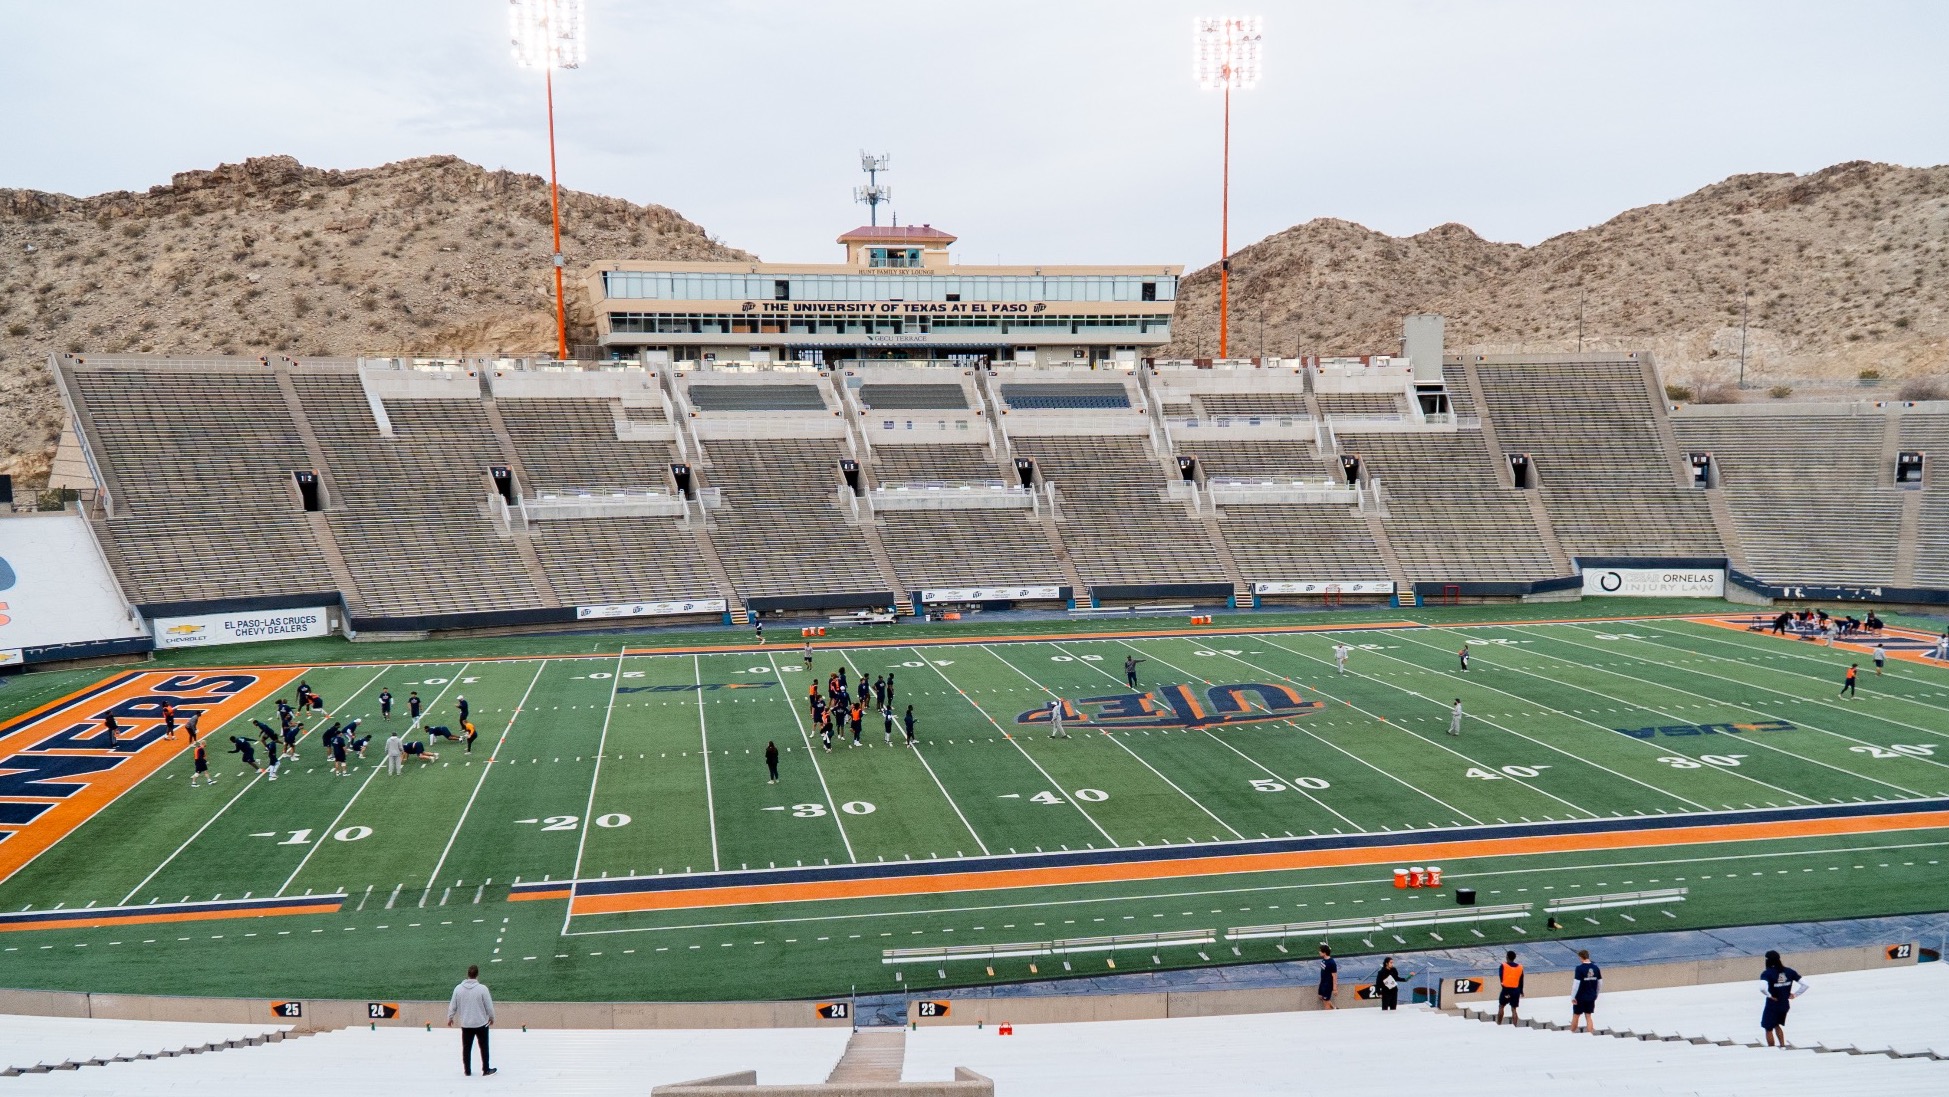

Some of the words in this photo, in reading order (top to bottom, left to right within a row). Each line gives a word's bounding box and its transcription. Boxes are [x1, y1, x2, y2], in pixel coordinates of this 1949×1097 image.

[763, 303, 789, 311] THE
[793, 303, 877, 312] UNIVERSITY
[881, 304, 899, 312] OF
[903, 304, 947, 312] TEXAS
[951, 304, 967, 312] AT
[972, 304, 987, 312] EL
[992, 304, 1028, 312] PASO
[1663, 574, 1714, 583] ORNELAS
[1625, 584, 1677, 592] INJURY
[1682, 584, 1714, 592] LAW
[224, 621, 236, 629] EL
[237, 619, 281, 628] PASO-LAS
[282, 615, 317, 626] CRUCES
[235, 627, 265, 637] CHEVY
[268, 624, 308, 634] DEALERS
[165, 635, 207, 644] CHEVROLET
[1849, 743, 1935, 759] 20
[0, 674, 260, 845] NERS
[1657, 754, 1741, 769] 30
[1464, 765, 1540, 780] 40
[1248, 776, 1331, 793] 50
[1028, 788, 1110, 806] 40
[791, 801, 876, 818] 30
[540, 813, 632, 831] 20
[277, 825, 373, 845] 10
[1897, 946, 1909, 958] 22
[1456, 980, 1470, 992] 22
[285, 1004, 299, 1016] 25
[370, 1004, 384, 1017] 24
[831, 1004, 845, 1017] 24
[922, 1002, 936, 1016] 23
